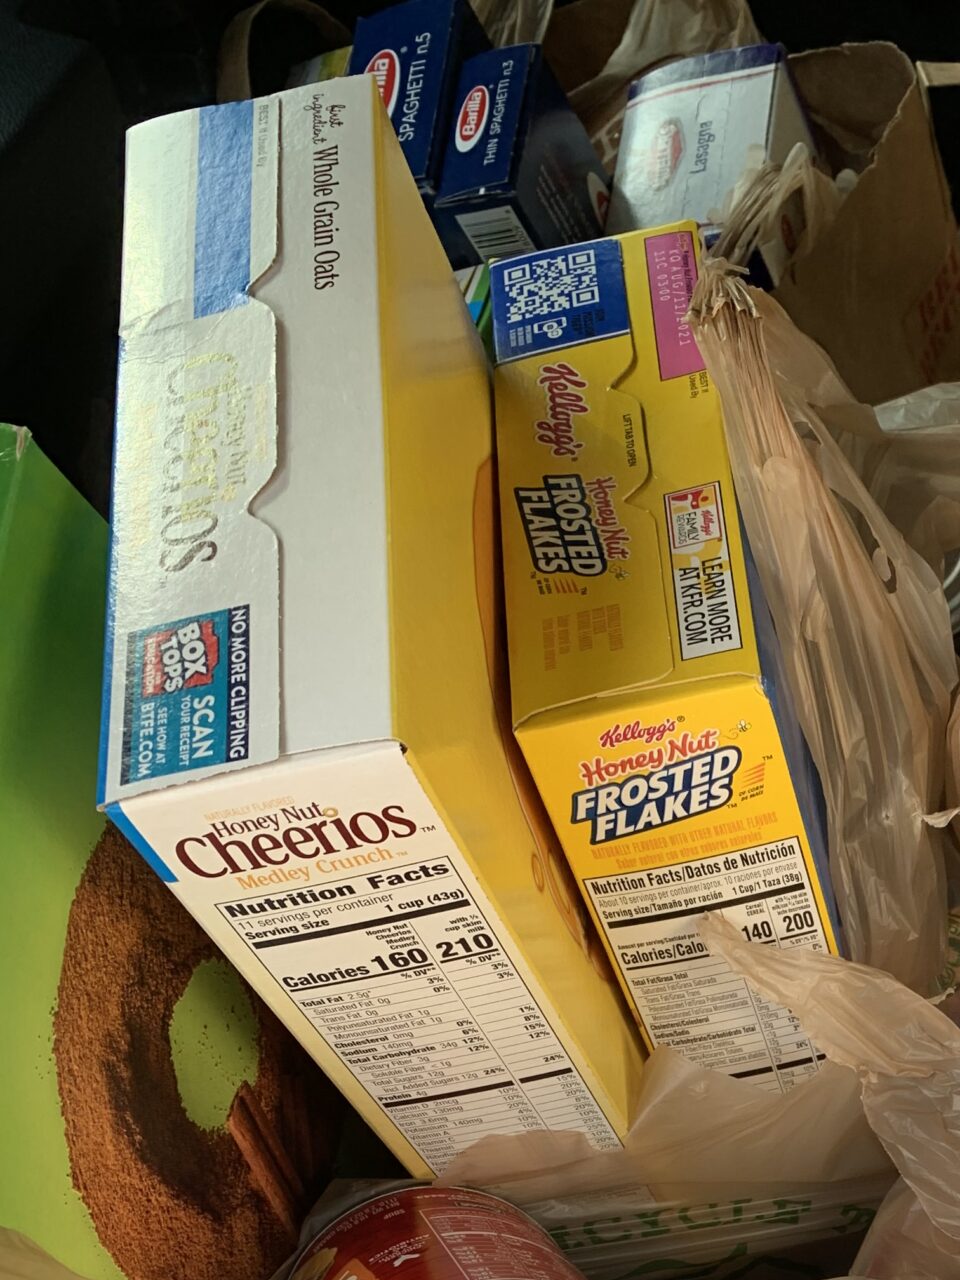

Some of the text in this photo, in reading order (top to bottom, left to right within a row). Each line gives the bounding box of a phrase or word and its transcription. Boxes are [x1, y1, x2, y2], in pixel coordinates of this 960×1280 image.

[398, 32, 431, 141] SPAGHETTI n.5
[462, 91, 482, 136] Barilla
[489, 79, 511, 135] SPAGHETTI
[303, 94, 327, 145] ingredient
[326, 104, 346, 128] first
[483, 138, 499, 166] THIN
[312, 144, 341, 290] Whole Grain Oats
[536, 363, 589, 459] Kellogg's
[518, 490, 571, 574] FLAKES
[548, 476, 604, 576] FROSTED
[586, 477, 632, 560] Honey Nut
[685, 511, 701, 541] FAMILY
[679, 567, 709, 647] AT KFR.COM
[701, 557, 733, 644] LEARN MORE
[160, 635, 184, 693] TOPS
[176, 622, 207, 679] BOX
[229, 608, 247, 759] NO MORE CLIPPING
[138, 702, 155, 778] BTFE.COM
[155, 707, 168, 764] SEE HOW AT
[179, 694, 191, 767] YOUR RECEIPT
[191, 695, 216, 759] SCAN
[599, 718, 677, 748] Kellogg's
[575, 747, 740, 821] FROSTED
[581, 729, 720, 787] Honey Nut
[211, 801, 323, 839] Honey Nut
[594, 776, 732, 843] FLAKES
[175, 804, 418, 879] Cheerios
[235, 846, 394, 891] Medley Crunch
[589, 842, 797, 896] Nutrition Facts/Datos de Nutrición
[223, 862, 451, 919] Nutrition Facts
[237, 892, 395, 931] 11 servings per container
[398, 899, 425, 912] cup
[426, 888, 466, 905] (43g)
[602, 890, 724, 920] Serving size/Tamaño por ración
[738, 881, 762, 895] Cup/1
[762, 877, 782, 889] Taza
[781, 871, 804, 886] (38g)
[244, 918, 331, 942] Serving size
[741, 920, 773, 943] 140
[782, 911, 815, 934] 200
[281, 933, 494, 989] Calories 160 210
